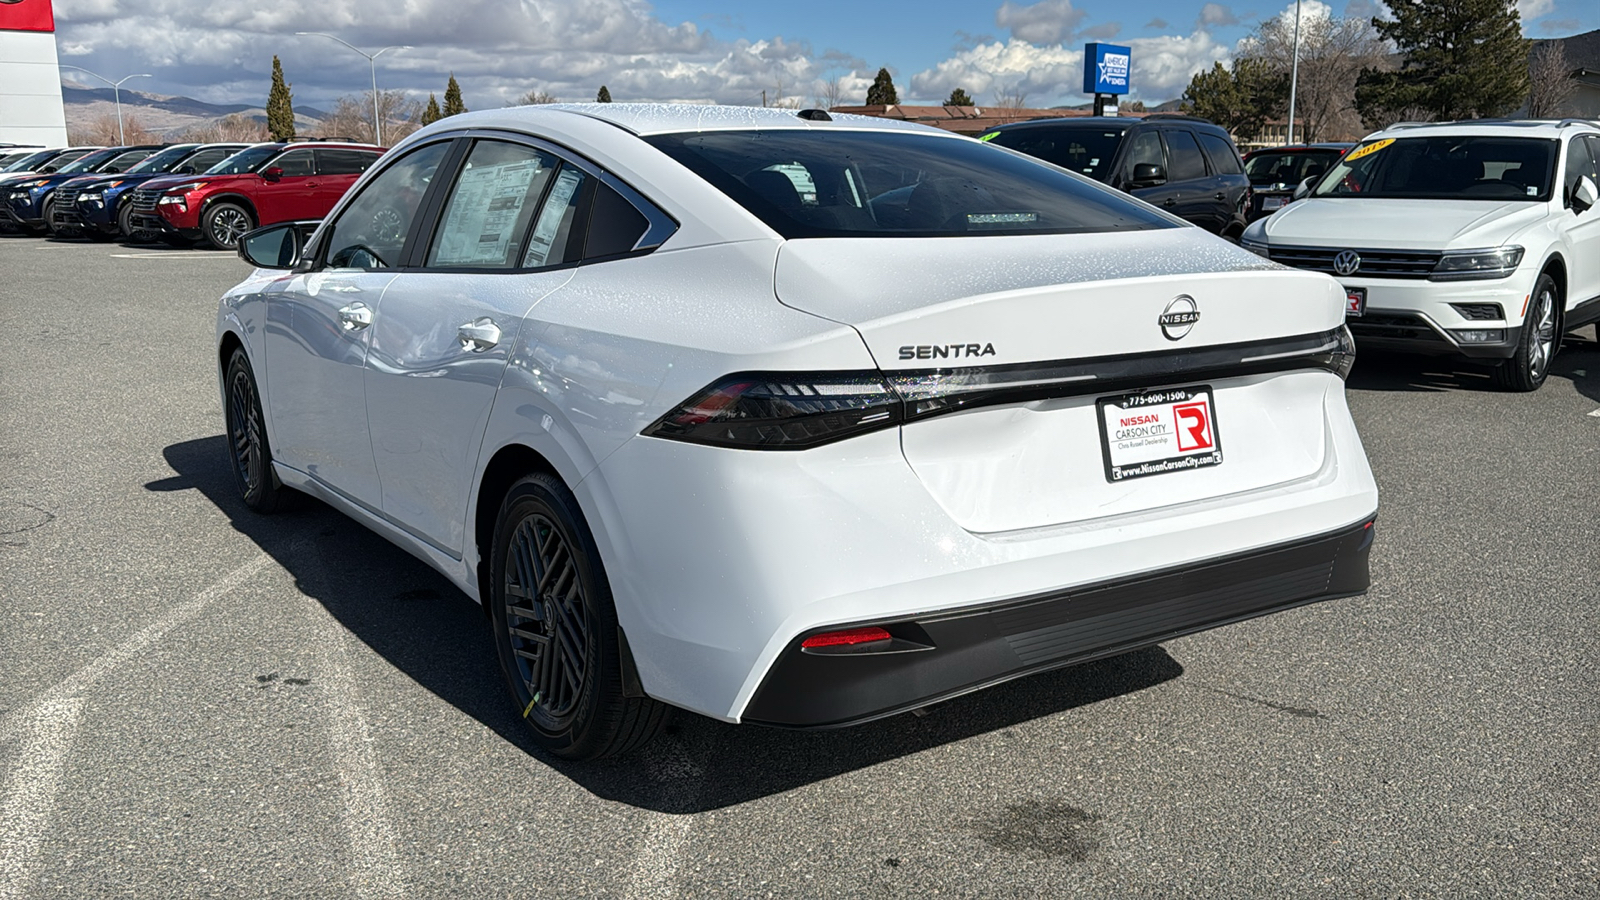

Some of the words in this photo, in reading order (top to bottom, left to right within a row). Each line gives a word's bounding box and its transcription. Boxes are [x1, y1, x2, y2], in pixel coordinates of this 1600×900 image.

[1355, 140, 1386, 158] 2019
[1160, 313, 1200, 324] NISSAN
[898, 342, 996, 360] SENTRA
[1129, 391, 1186, 406] 775-600-1500
[1120, 414, 1159, 427] NISSAN
[1116, 427, 1149, 440] CARSON
[1150, 424, 1167, 435] CITY
[1118, 442, 1129, 450] Chris
[1130, 439, 1144, 448] Russell
[1145, 437, 1168, 446] Dealership
[1122, 456, 1213, 477] www.NissanCarsonCity.com
